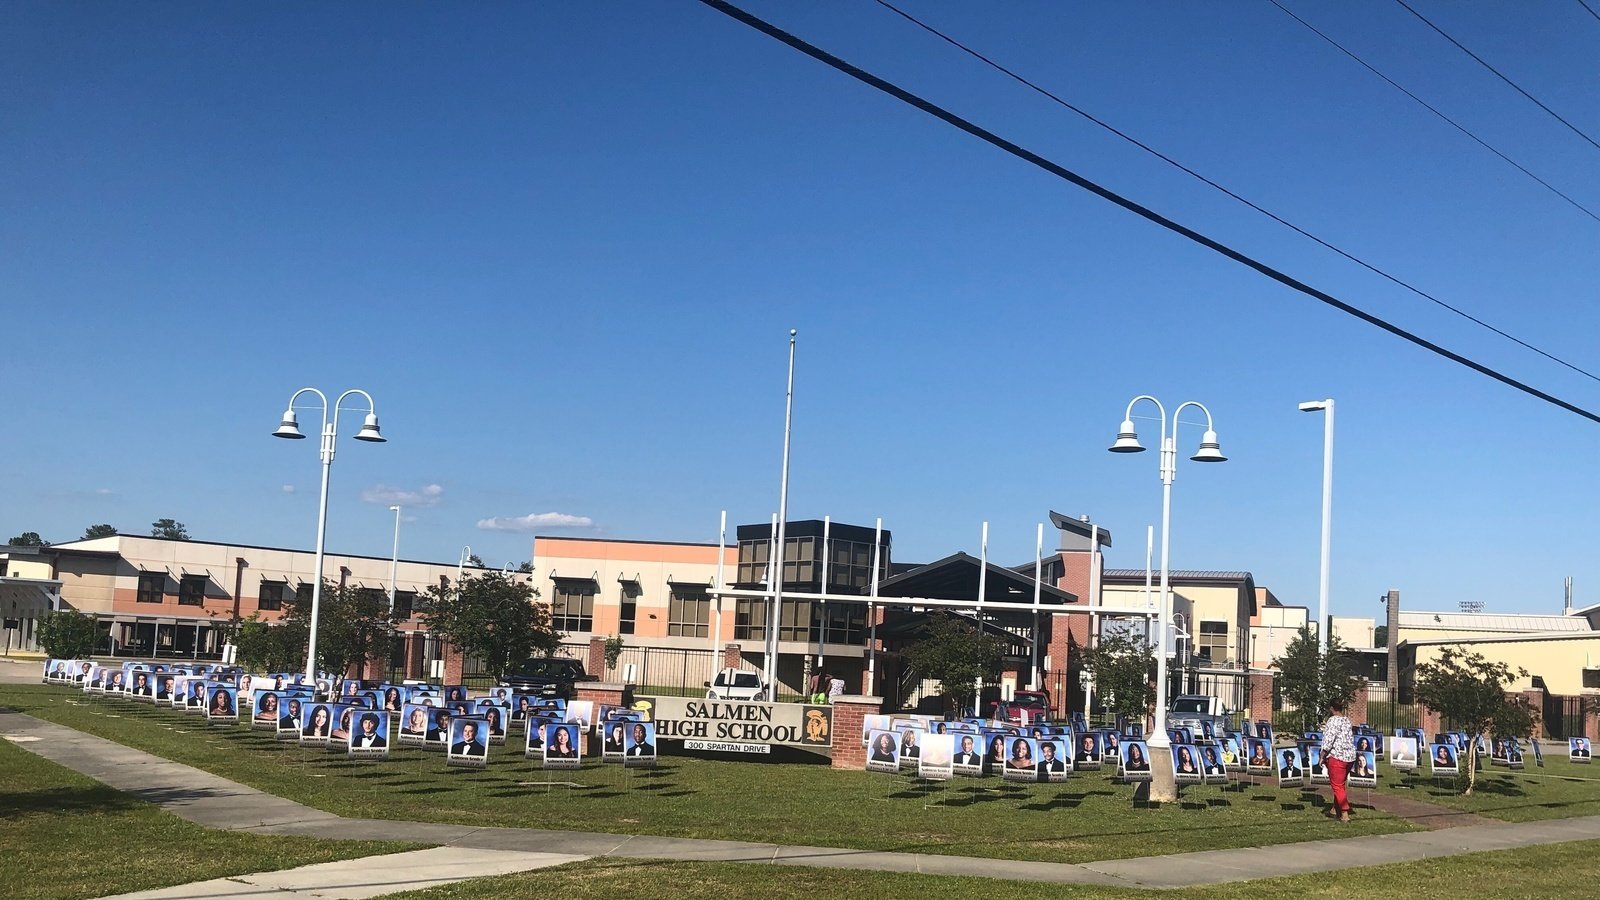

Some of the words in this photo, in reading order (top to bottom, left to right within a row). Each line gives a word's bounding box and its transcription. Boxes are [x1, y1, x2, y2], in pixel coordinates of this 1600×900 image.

[686, 702, 773, 722] SALMEN
[655, 720, 709, 737] HIGH
[717, 722, 802, 742] SCHOOL
[707, 743, 740, 751] SPARTAN
